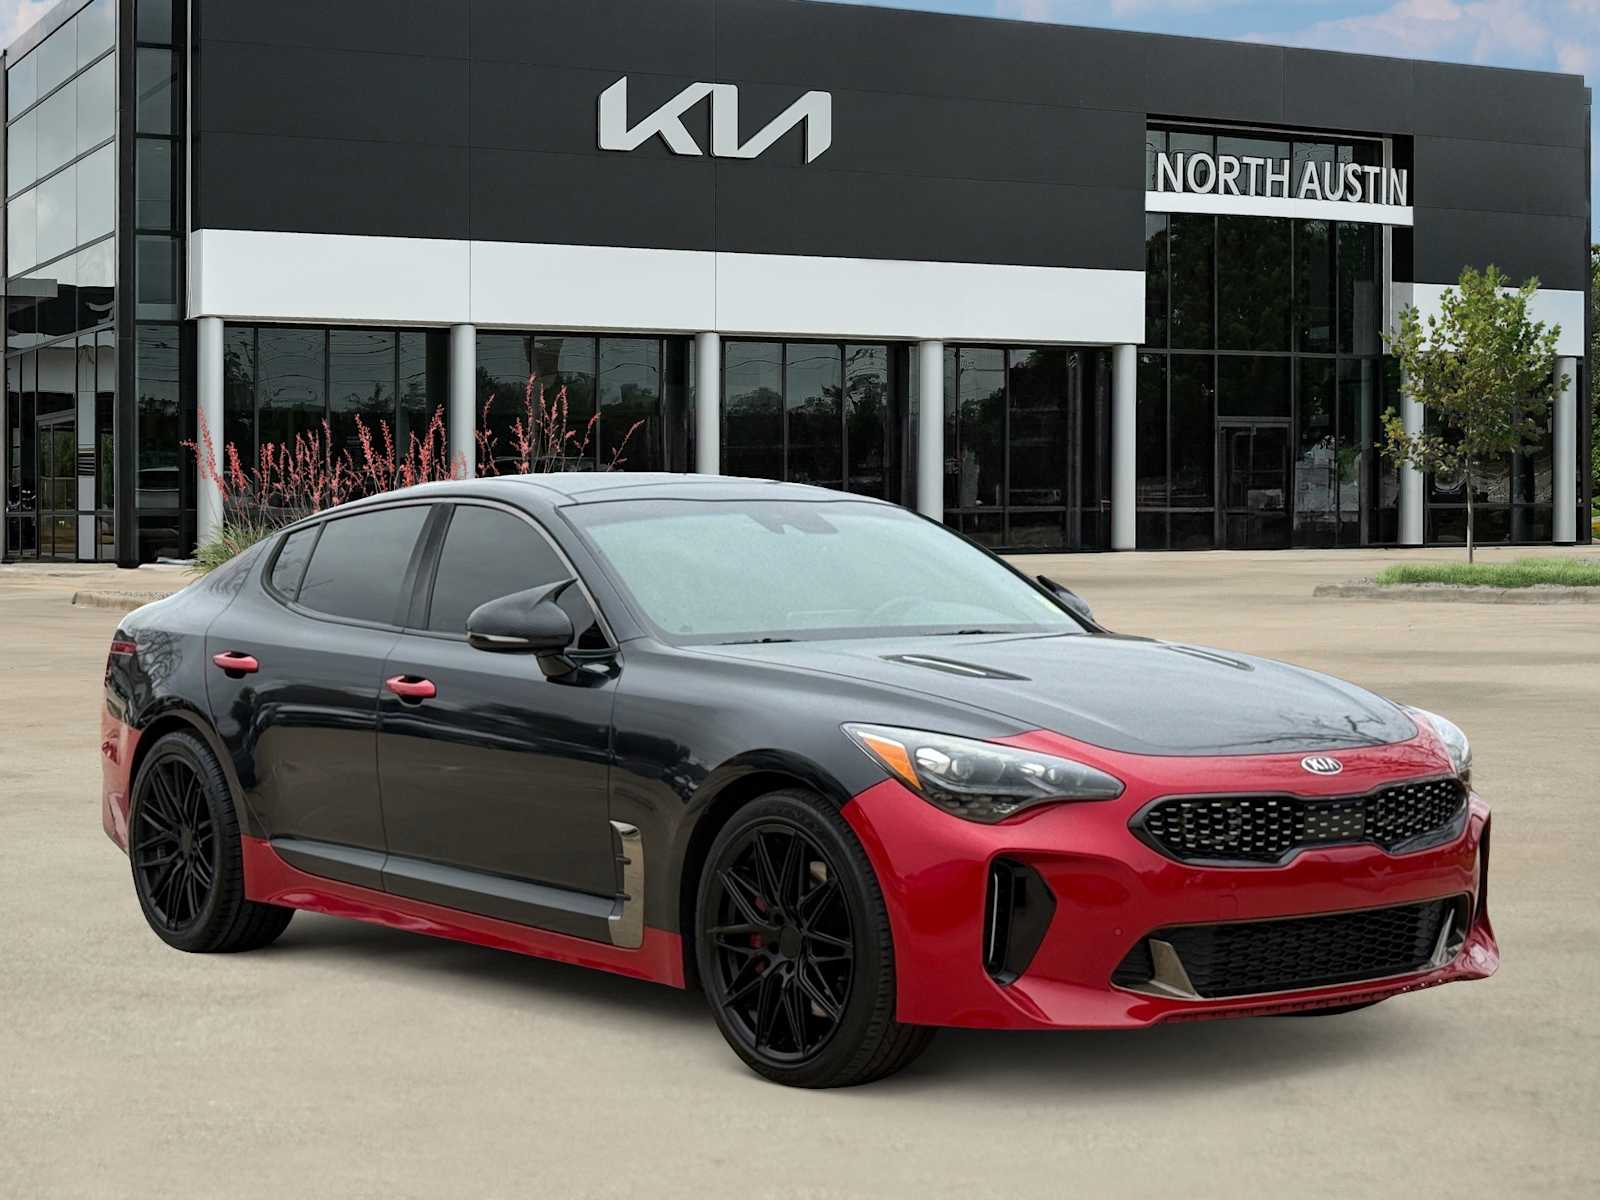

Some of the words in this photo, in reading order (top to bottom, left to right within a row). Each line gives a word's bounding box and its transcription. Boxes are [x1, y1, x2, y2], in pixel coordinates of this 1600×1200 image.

[598, 75, 832, 164] KIA
[1157, 152, 1290, 198] NORTH
[1299, 160, 1408, 206] AUSTIN
[1303, 757, 1342, 773] KIA
